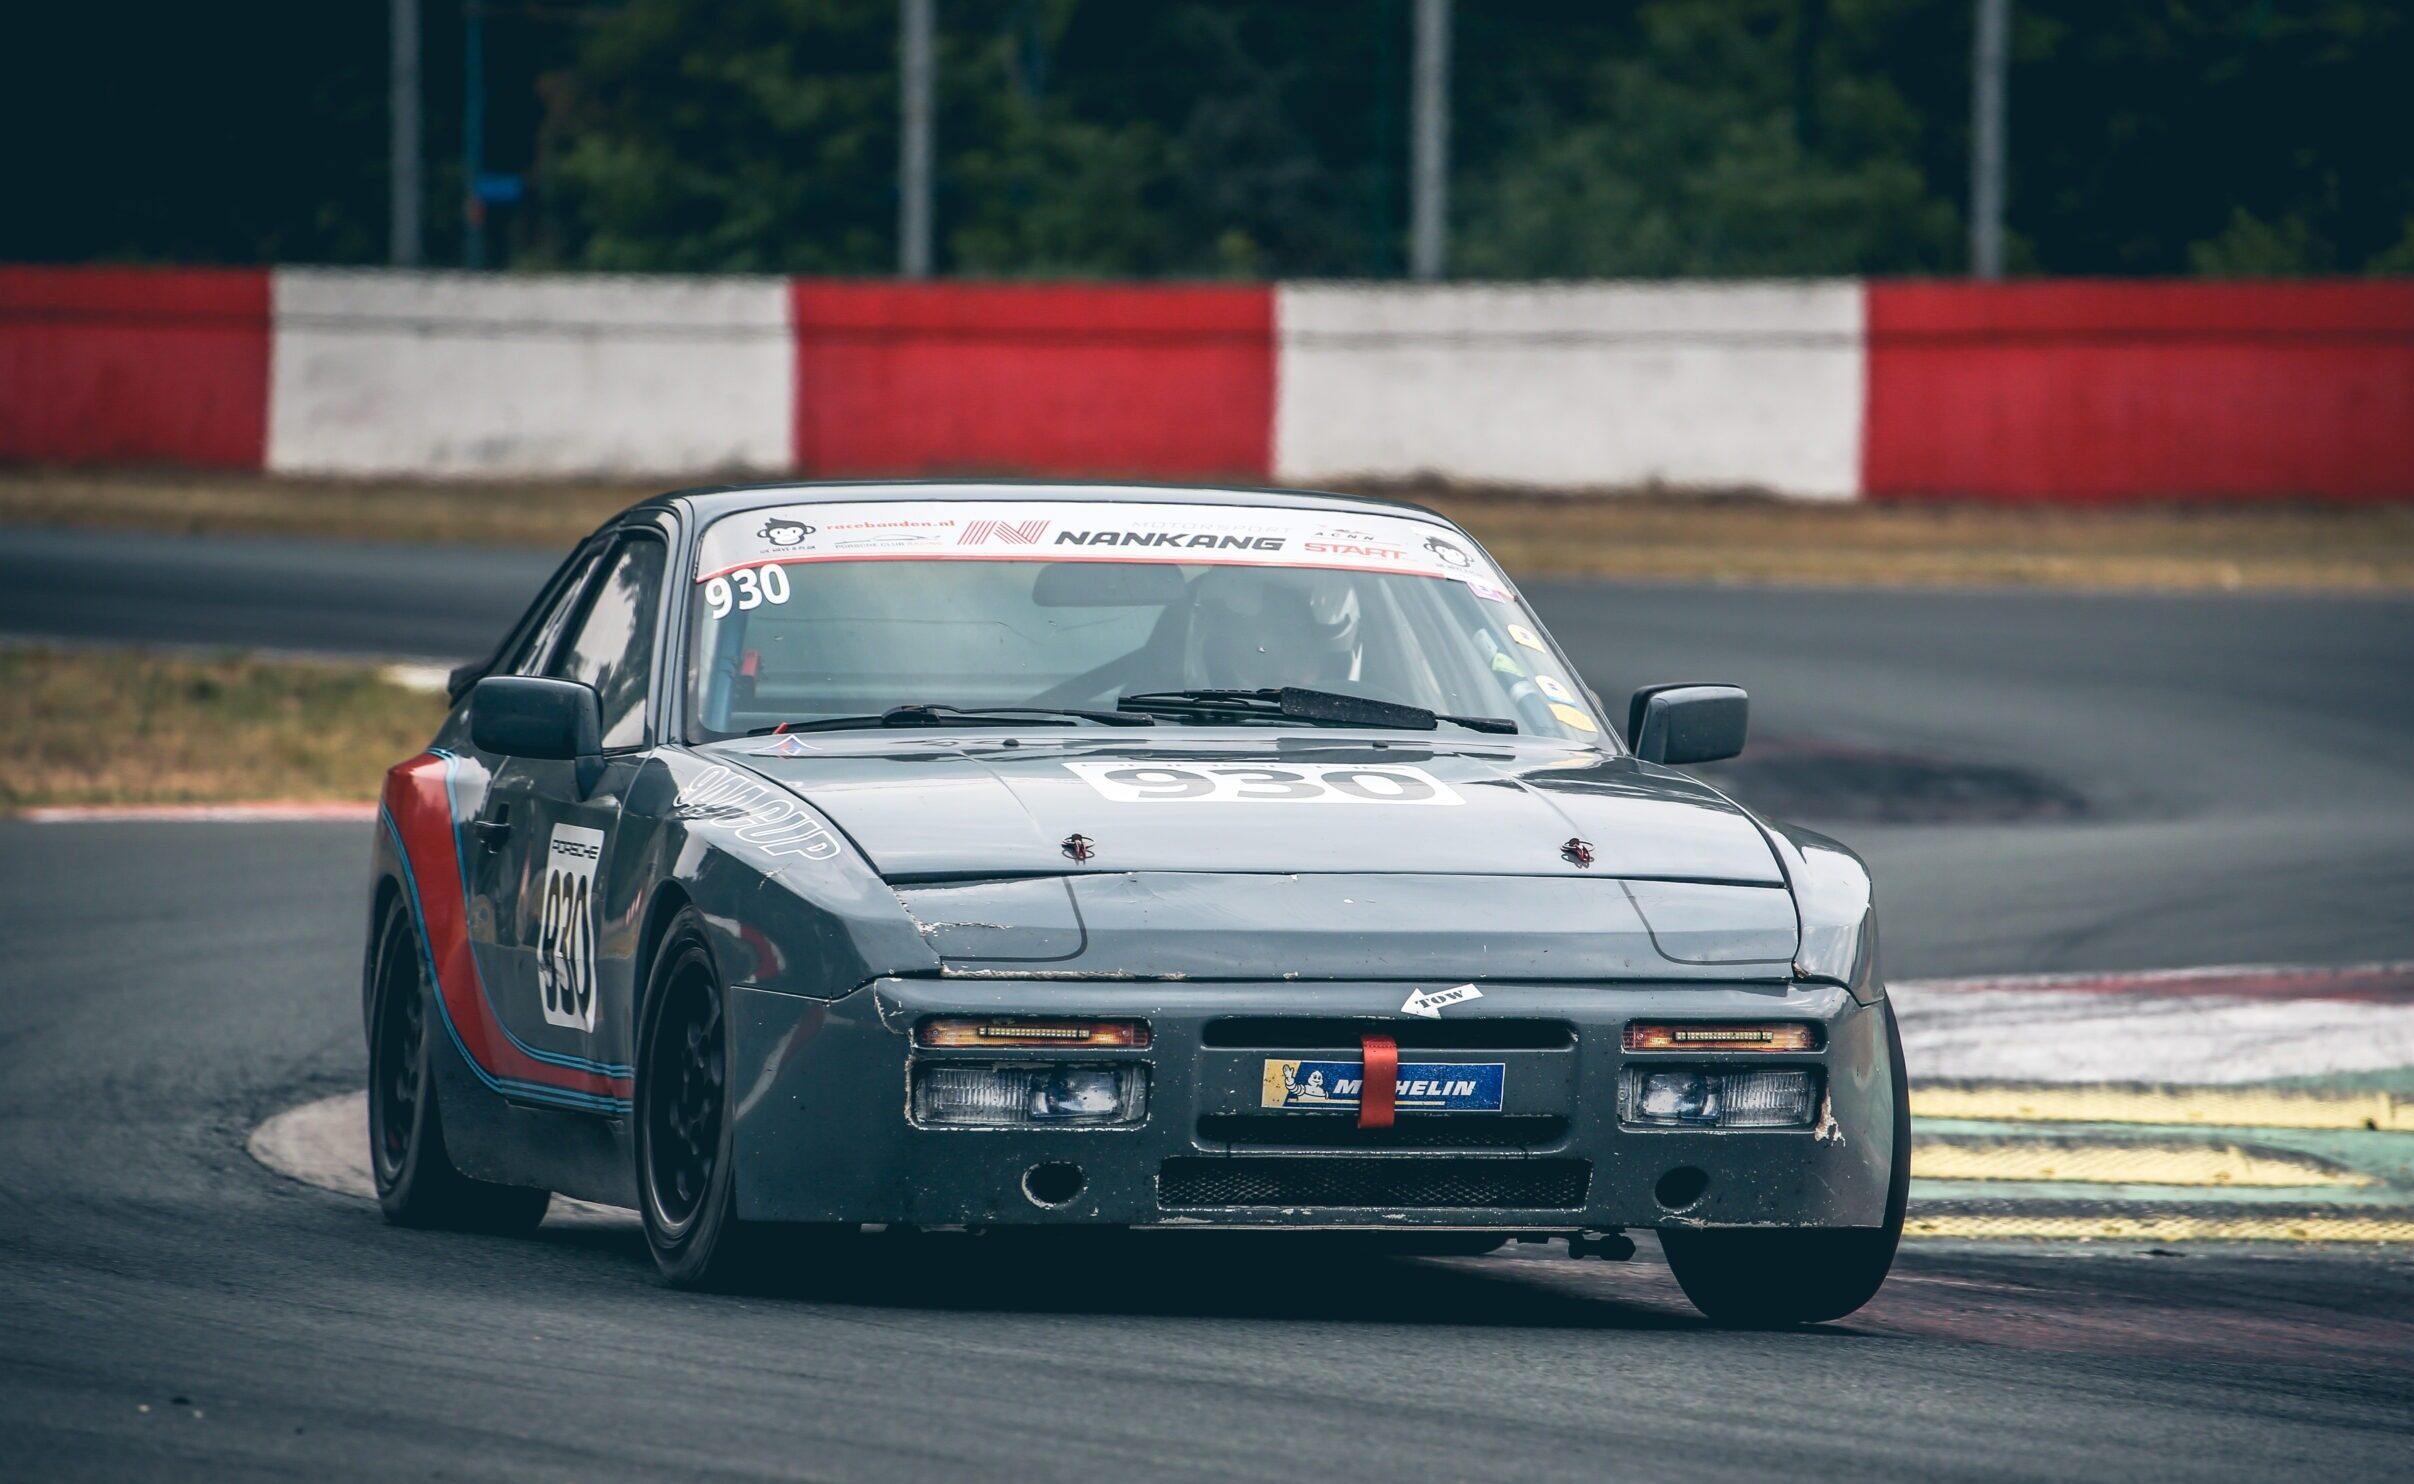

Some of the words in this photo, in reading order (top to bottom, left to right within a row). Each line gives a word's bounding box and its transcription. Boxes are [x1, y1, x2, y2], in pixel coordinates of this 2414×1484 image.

[1054, 530, 1288, 551] NANKANG
[1303, 542, 1409, 560] START
[704, 563, 791, 620] 930
[1103, 768, 1438, 801] 930
[552, 839, 599, 860] PORSCHE
[541, 869, 595, 1017] 930
[1333, 1078, 1477, 1097] MHELIN
